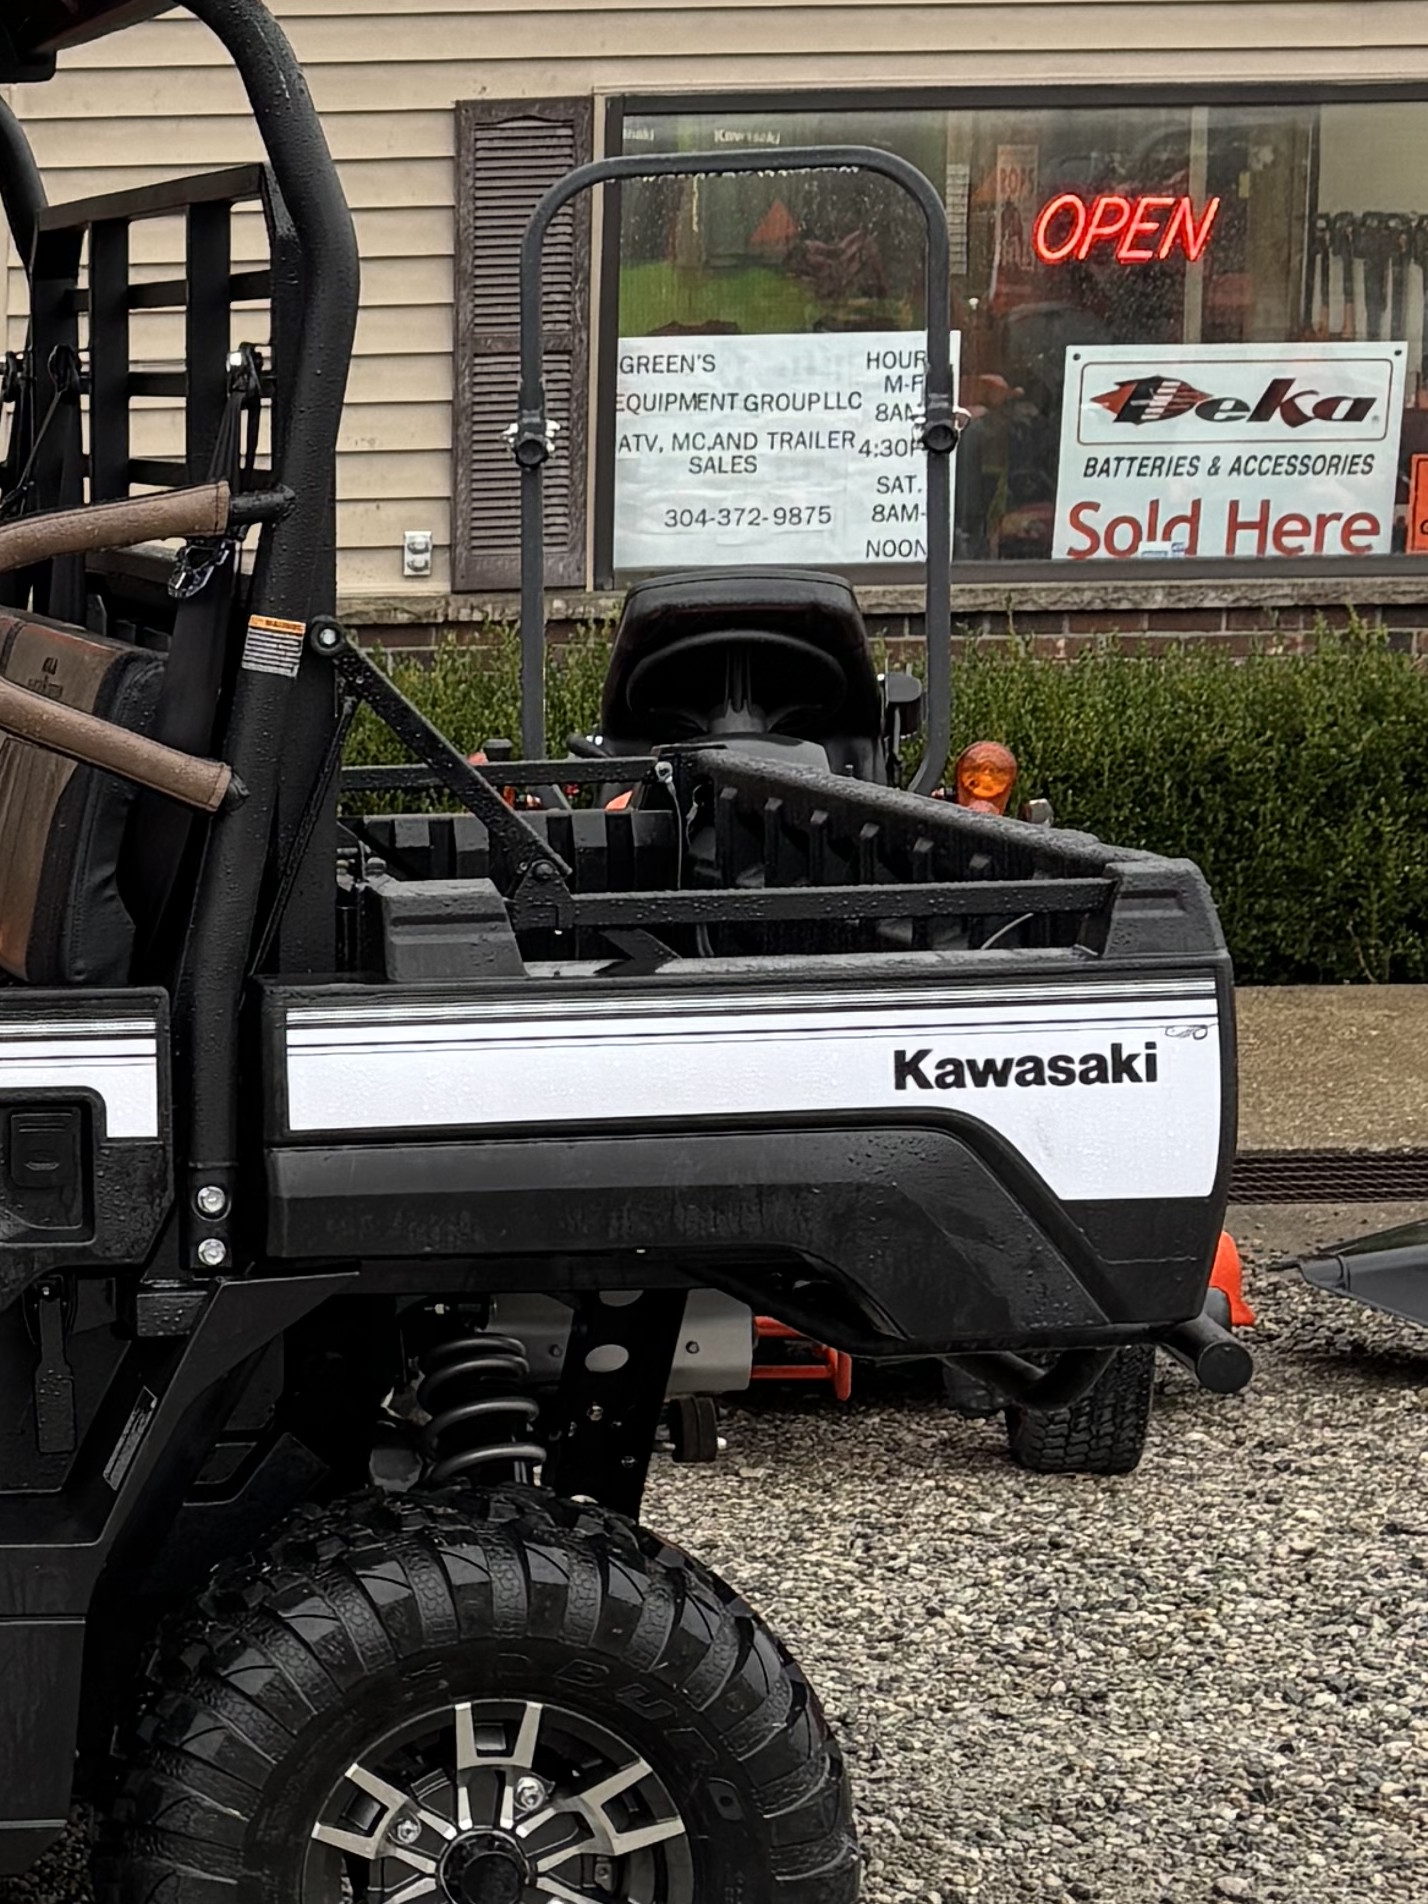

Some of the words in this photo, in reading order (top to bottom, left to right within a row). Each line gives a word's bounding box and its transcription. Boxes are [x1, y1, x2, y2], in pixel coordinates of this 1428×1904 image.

[1033, 193, 1221, 265] OPEN
[619, 353, 717, 375] GREEN'S
[866, 349, 927, 370] HOUR
[615, 392, 740, 415] EQUIPMENT
[743, 392, 821, 413] GROUP
[823, 390, 863, 411] LLC
[1090, 374, 1378, 428] Deka
[618, 432, 665, 454] ATV,
[767, 430, 857, 451] TRAILER
[688, 455, 758, 475] SALES
[1083, 455, 1201, 479] BATTERIES
[1207, 457, 1222, 476] &
[1228, 454, 1376, 478] ACCESSORIES
[876, 474, 923, 495] SAT.
[664, 506, 833, 528] 304-372-9875
[1066, 498, 1203, 559] Sold
[1226, 498, 1382, 557] Here
[865, 538, 928, 559] NOON
[893, 1040, 1158, 1091] Kawasaki
